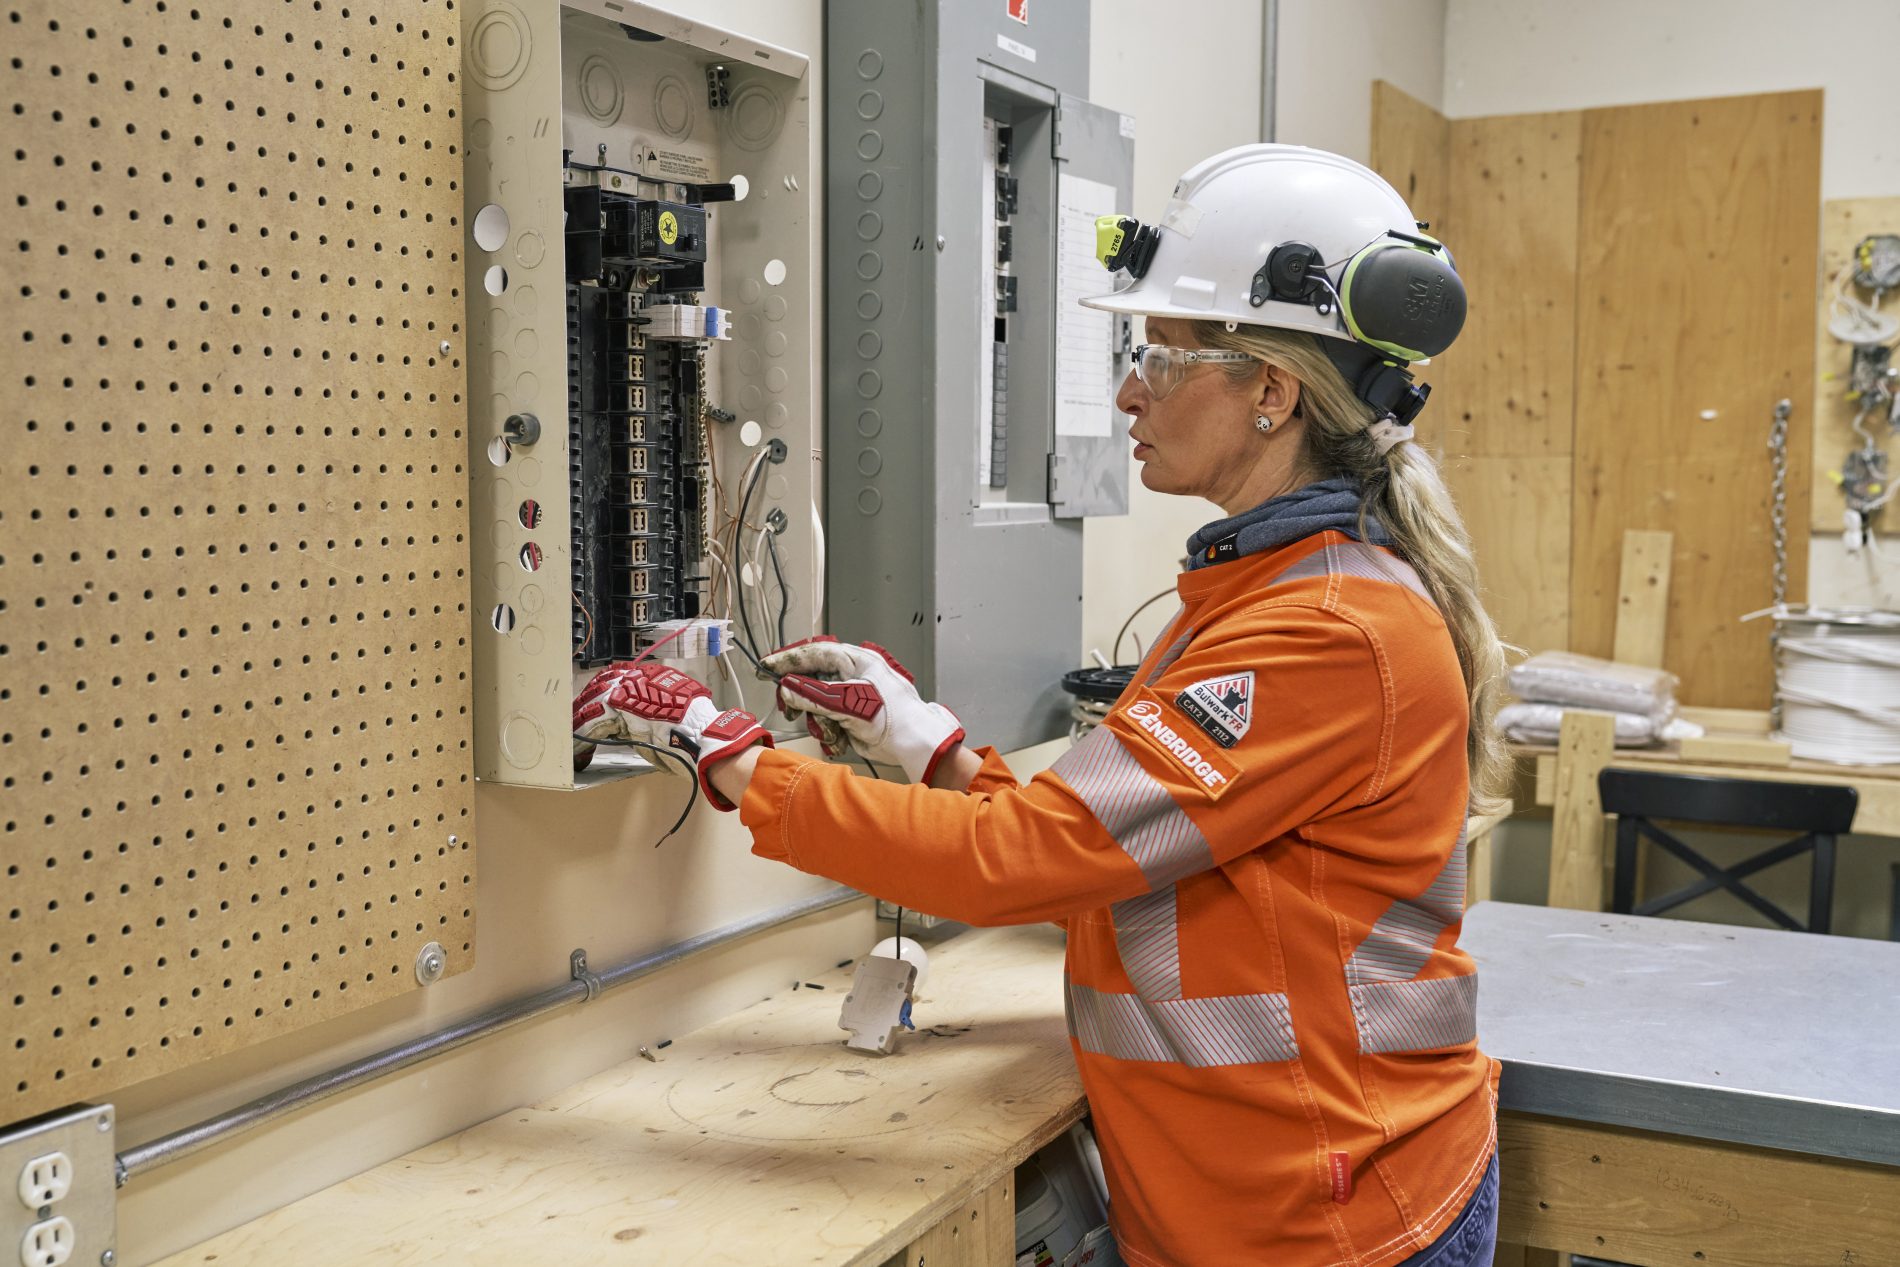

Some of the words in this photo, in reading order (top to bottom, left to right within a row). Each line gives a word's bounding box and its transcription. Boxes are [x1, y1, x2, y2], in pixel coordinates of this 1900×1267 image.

[1111, 234, 1122, 252] 2765
[1194, 686, 1229, 721] Bulwark
[1212, 726, 1230, 743] 2112
[1140, 714, 1224, 787] ENBRIDGE
